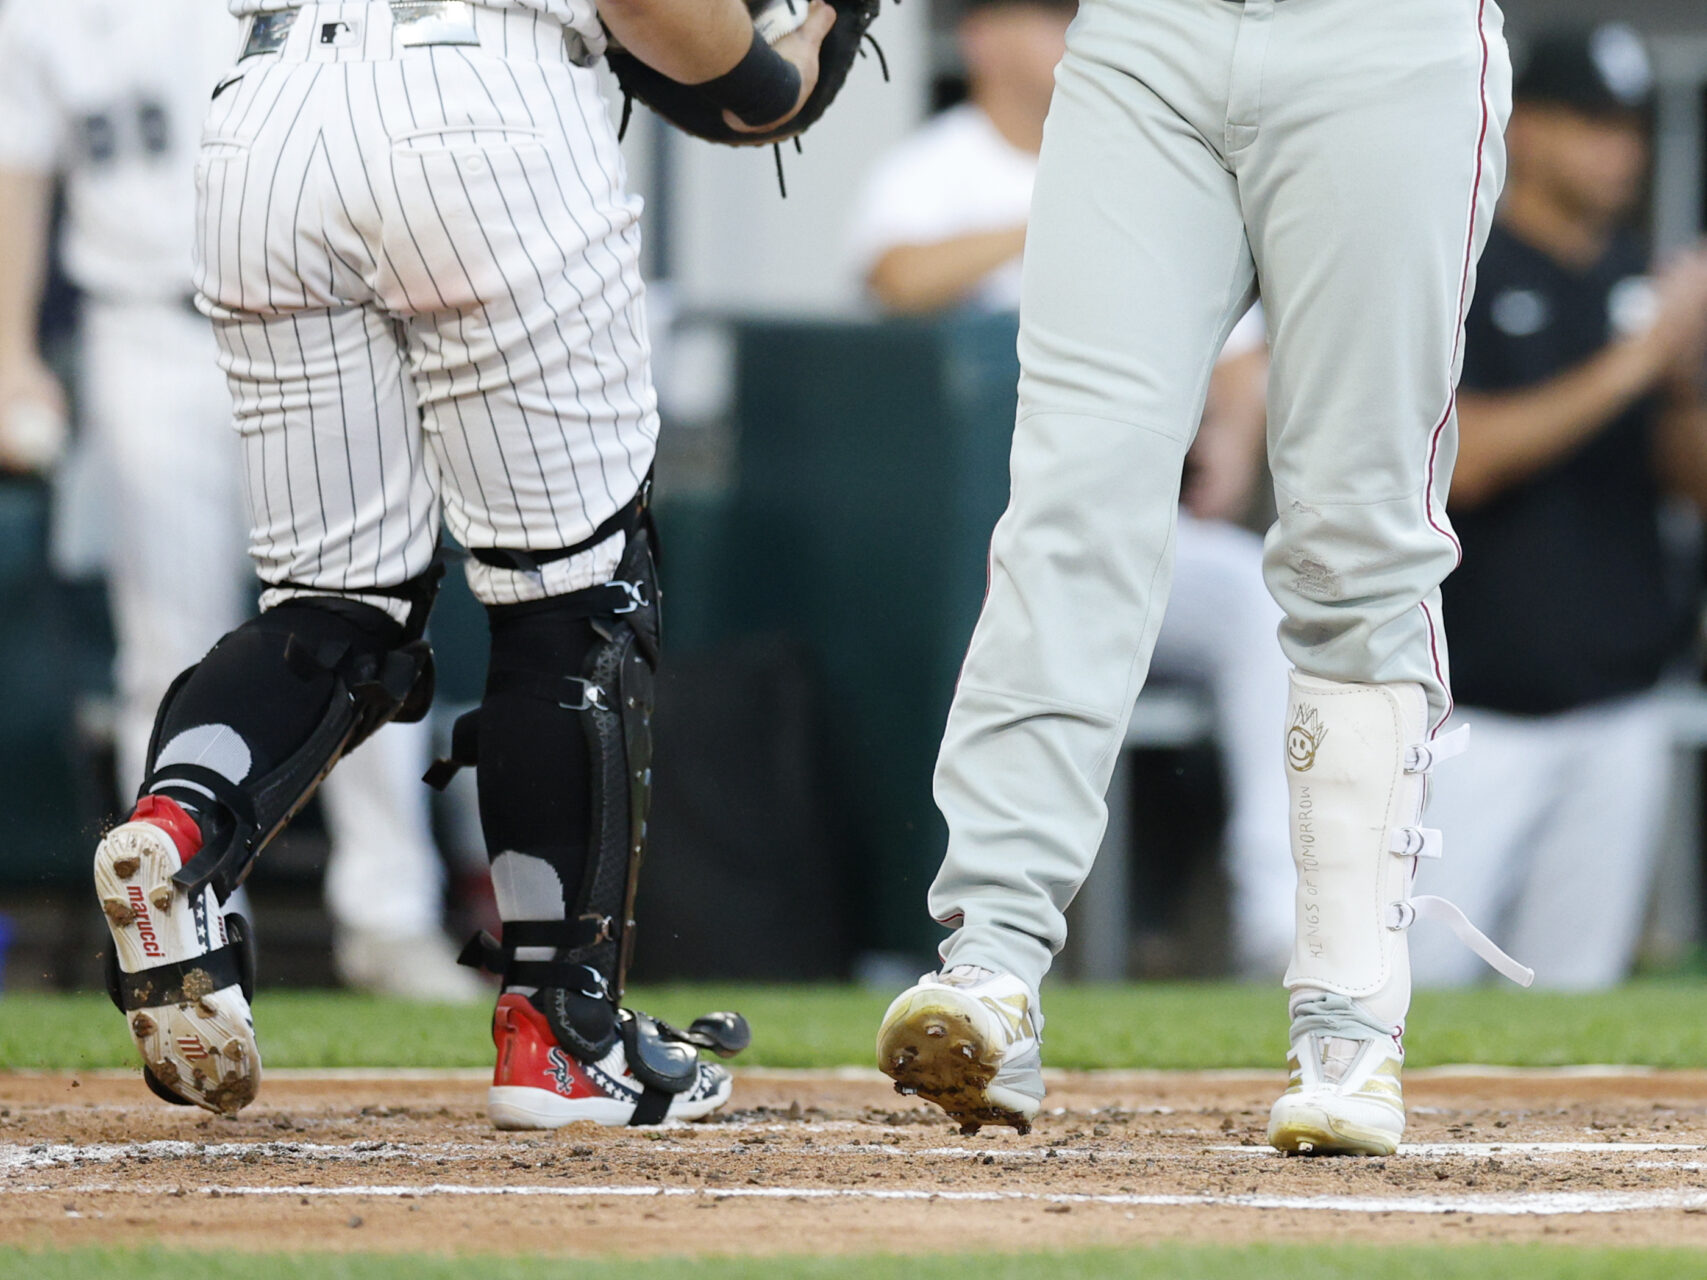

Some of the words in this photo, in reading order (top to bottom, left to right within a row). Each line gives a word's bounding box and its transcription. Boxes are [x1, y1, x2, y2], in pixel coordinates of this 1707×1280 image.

[1299, 785, 1319, 873] TOMORROW
[1306, 879, 1319, 896] OF
[126, 885, 166, 957] marucci
[1305, 903, 1323, 959] KINGS
